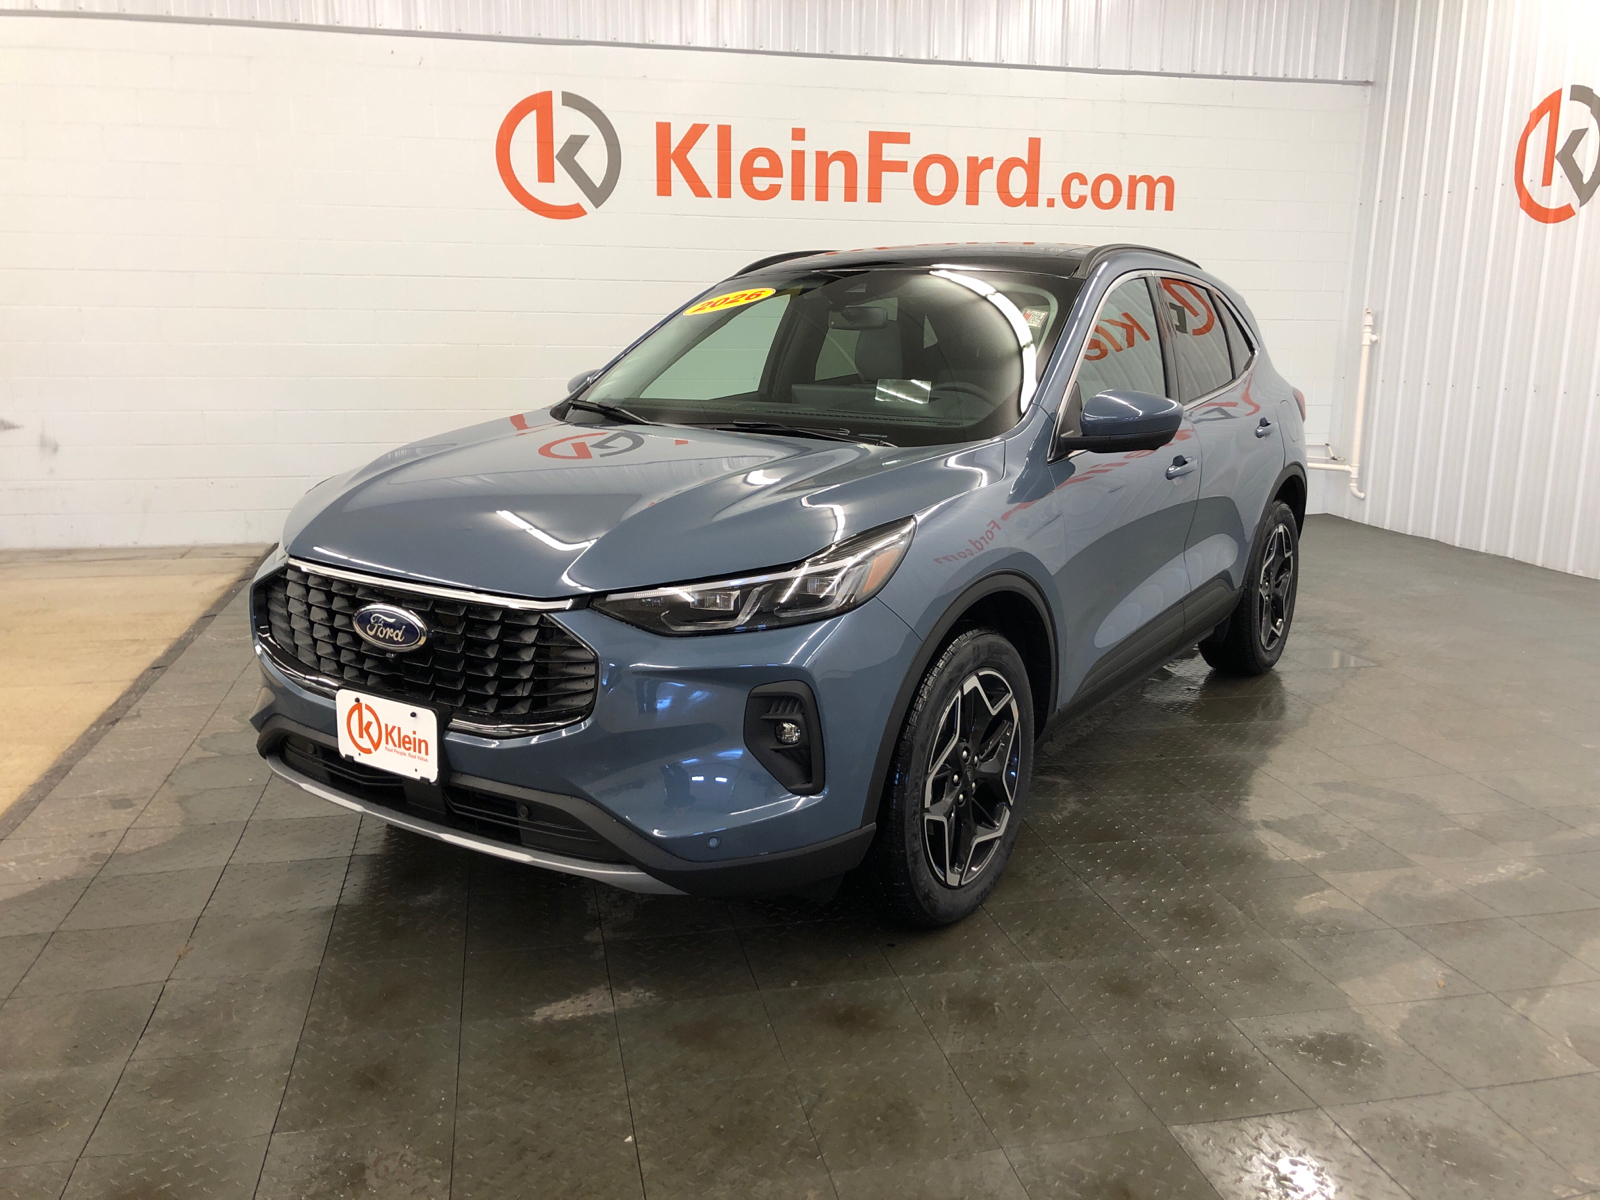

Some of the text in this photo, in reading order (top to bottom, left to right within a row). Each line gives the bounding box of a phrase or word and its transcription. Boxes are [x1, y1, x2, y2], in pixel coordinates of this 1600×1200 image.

[656, 121, 1175, 211] KleinFord.com
[690, 290, 767, 313] 2026
[366, 613, 406, 642] Ford
[384, 723, 429, 756] Klein
